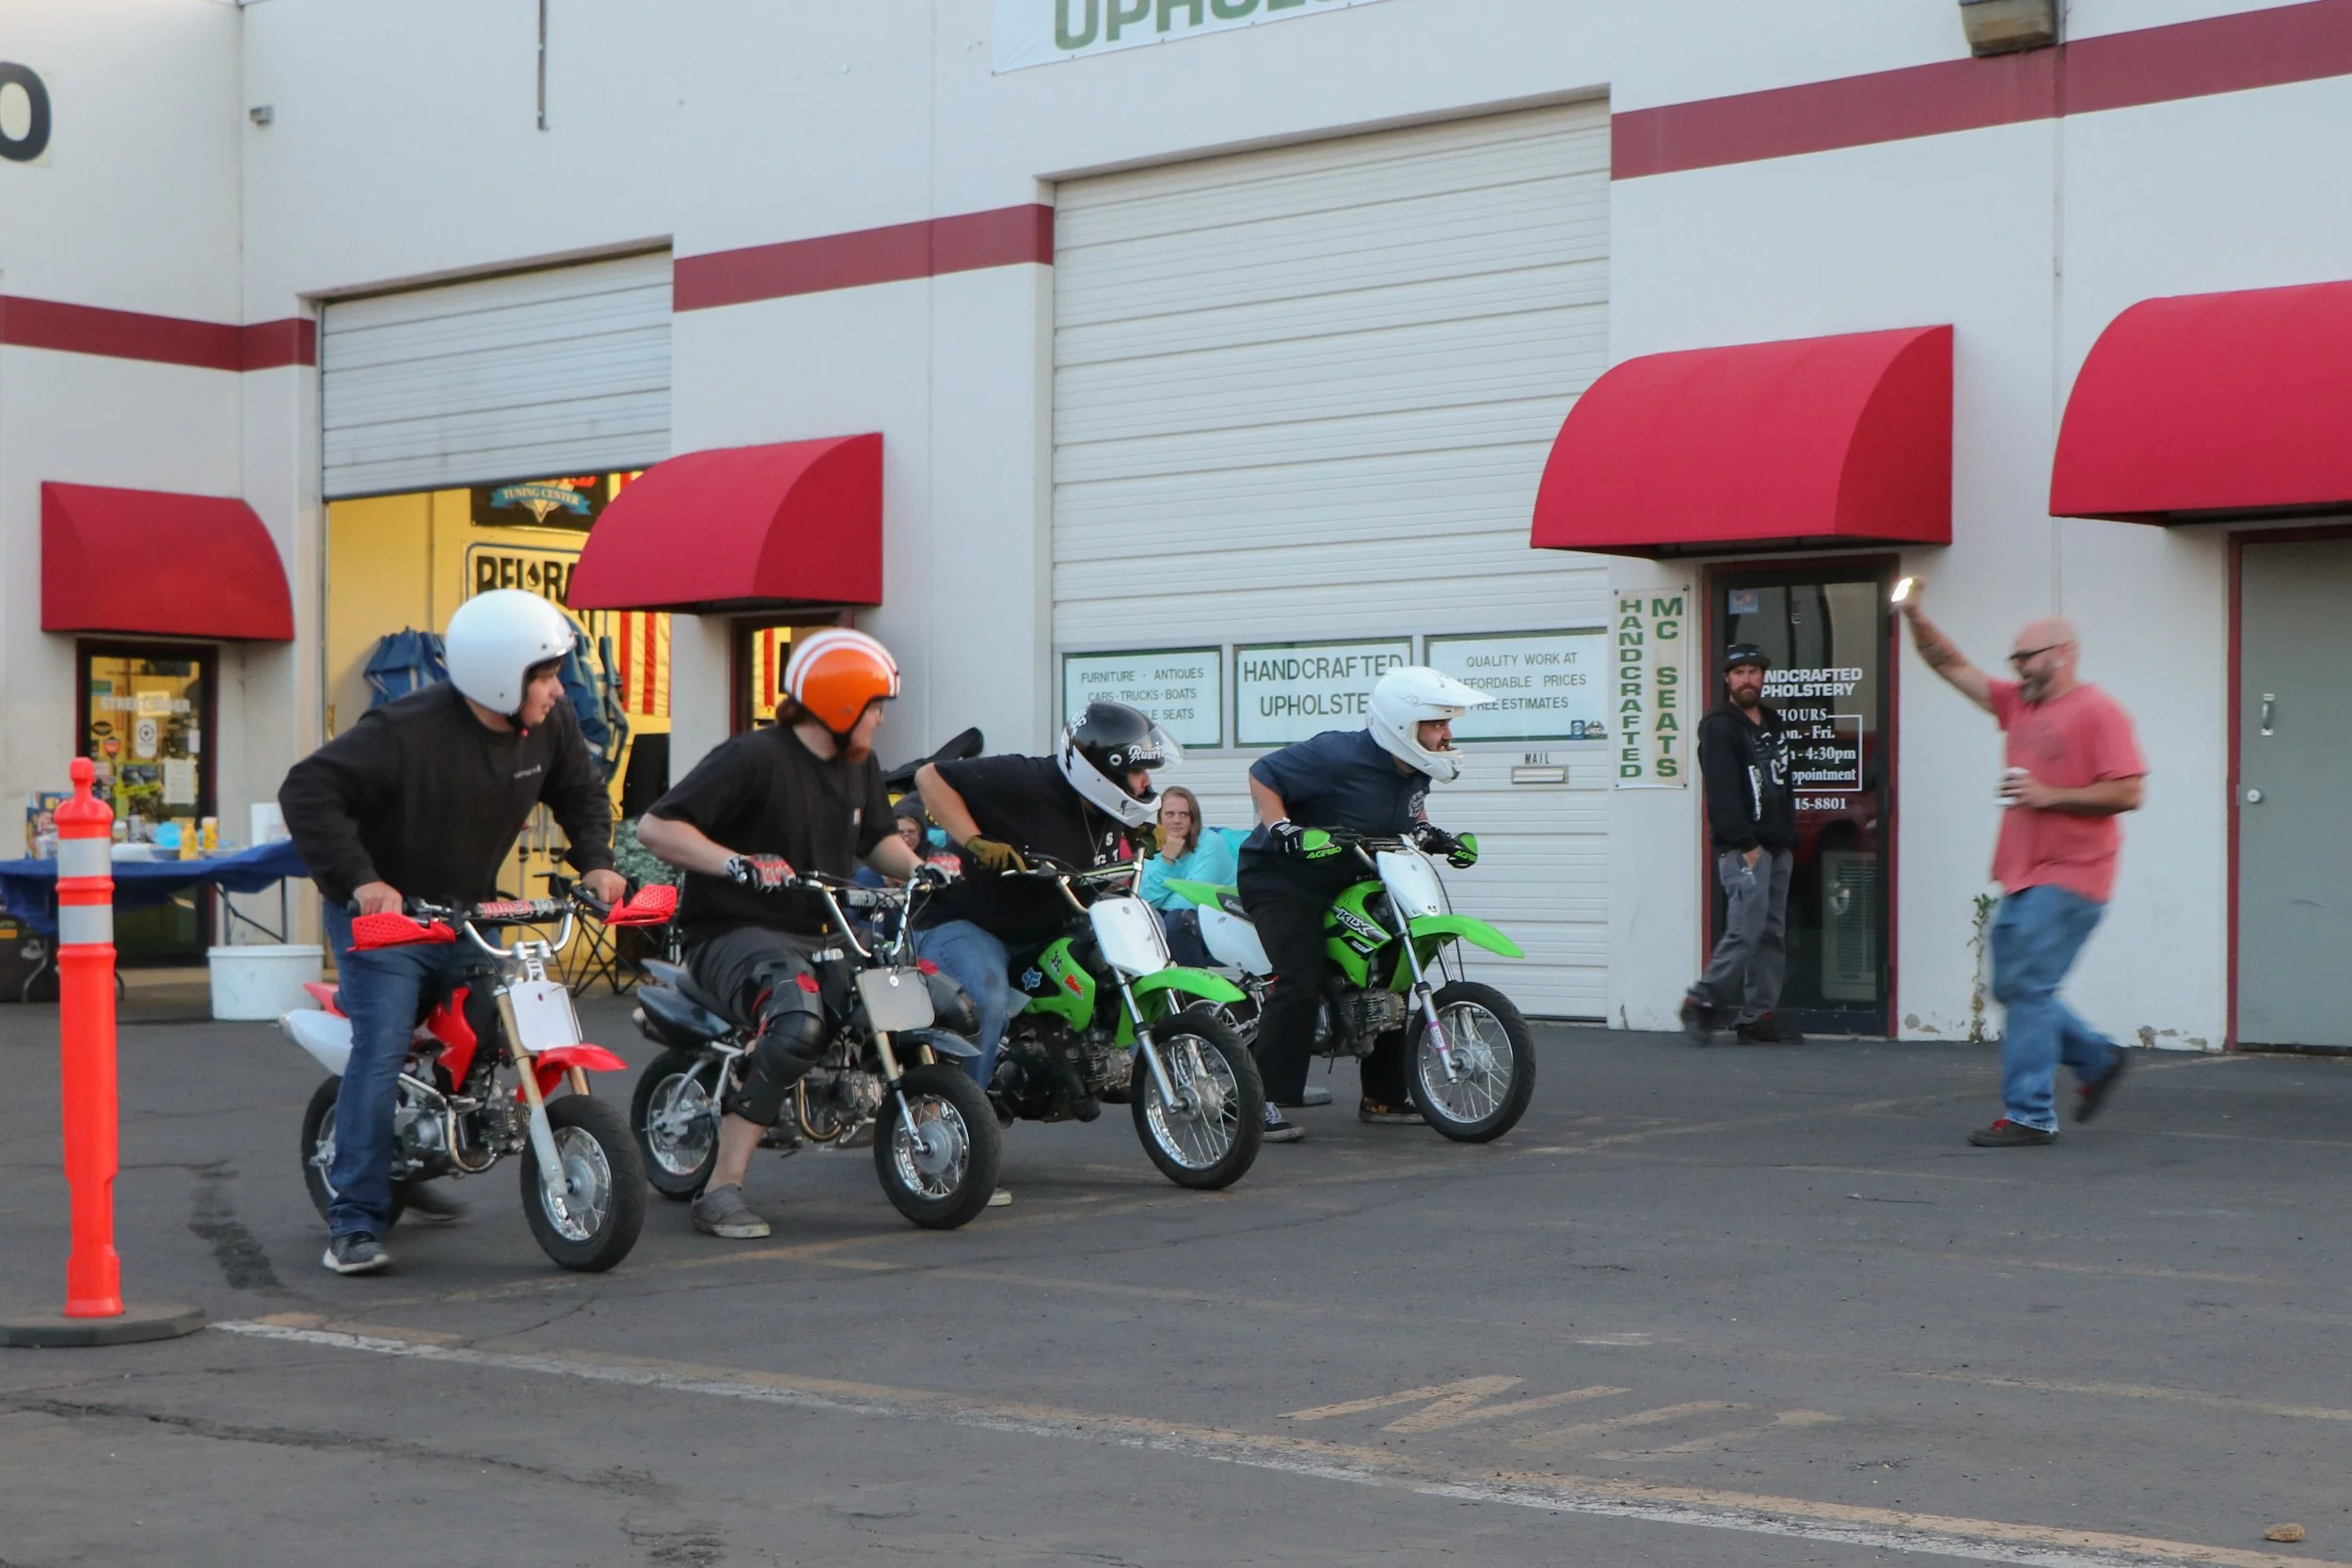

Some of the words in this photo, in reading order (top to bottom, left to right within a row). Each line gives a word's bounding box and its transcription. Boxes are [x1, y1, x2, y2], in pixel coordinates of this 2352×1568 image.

[501, 486, 539, 499] TUNING
[541, 488, 580, 505] CENTER
[1651, 596, 1683, 640] MC
[1466, 655, 1518, 668] QUALITY
[1524, 654, 1561, 666] WORK
[1563, 652, 1578, 664] AT
[1081, 671, 1136, 684] FURNITURE
[1154, 668, 1204, 680] ANTIQUES
[1544, 673, 1587, 688] PRICES
[1763, 668, 1863, 683] NDCRAFTED
[1619, 598, 1643, 779] HANDCRAFTED
[1760, 683, 1855, 698] PHOLSTERY
[1261, 692, 1371, 717] UPHOLSTE
[1502, 697, 1568, 710] ESTIMATES
[1163, 708, 1195, 721] SEATS
[1656, 666, 1679, 778] SEATS
[1812, 725, 1836, 739] Fri.
[1525, 752, 1550, 765] MAIL
[1805, 746, 1856, 764] 4:30pm
[1792, 768, 1856, 785] ppointment
[1336, 908, 1377, 937] KLX
